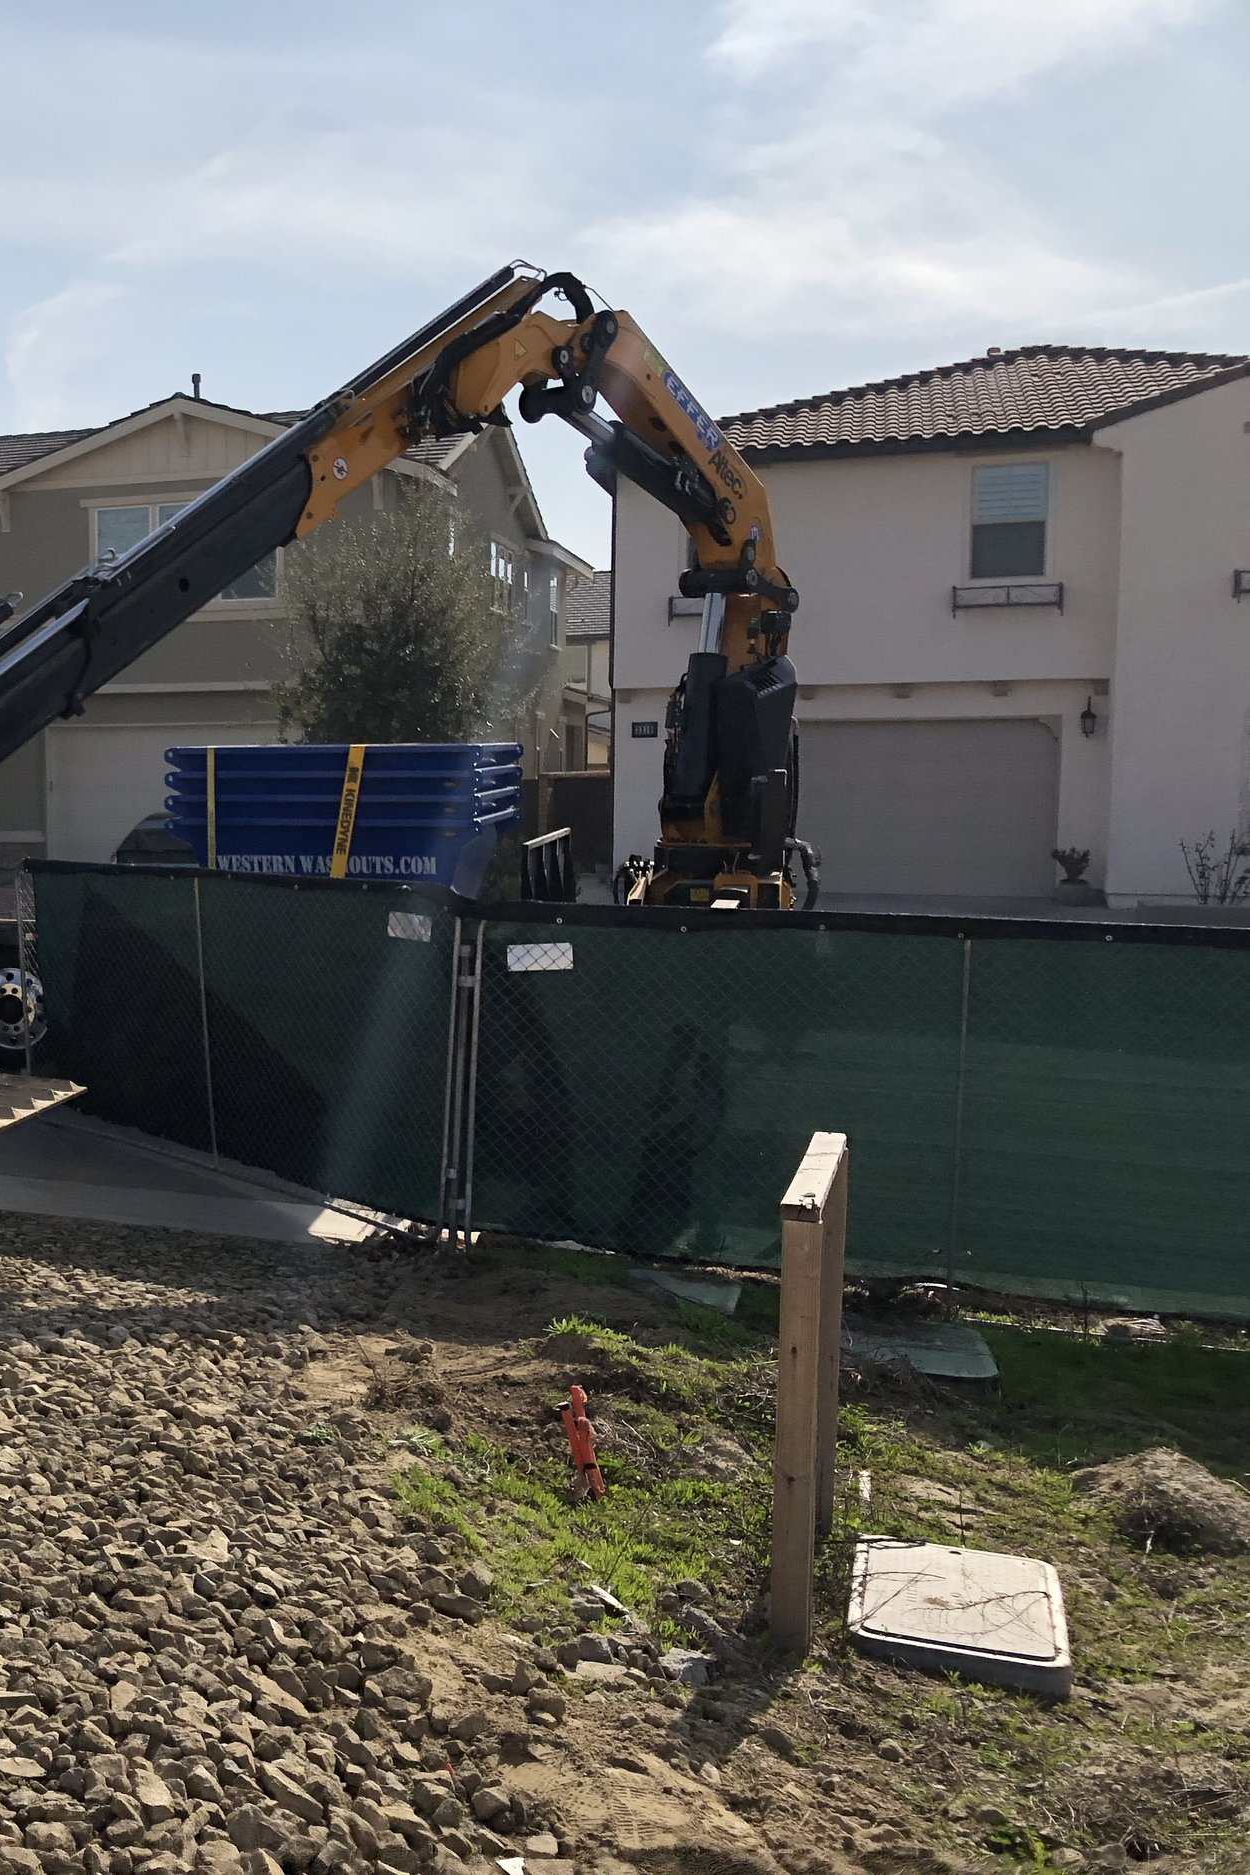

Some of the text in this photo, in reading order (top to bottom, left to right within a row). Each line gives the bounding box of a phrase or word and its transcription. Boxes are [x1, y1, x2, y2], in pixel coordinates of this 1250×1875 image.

[666, 377, 720, 446] EFFER
[335, 788, 356, 855] KINEDYNE
[216, 854, 437, 875] WESTERN WASOUTS.COM
